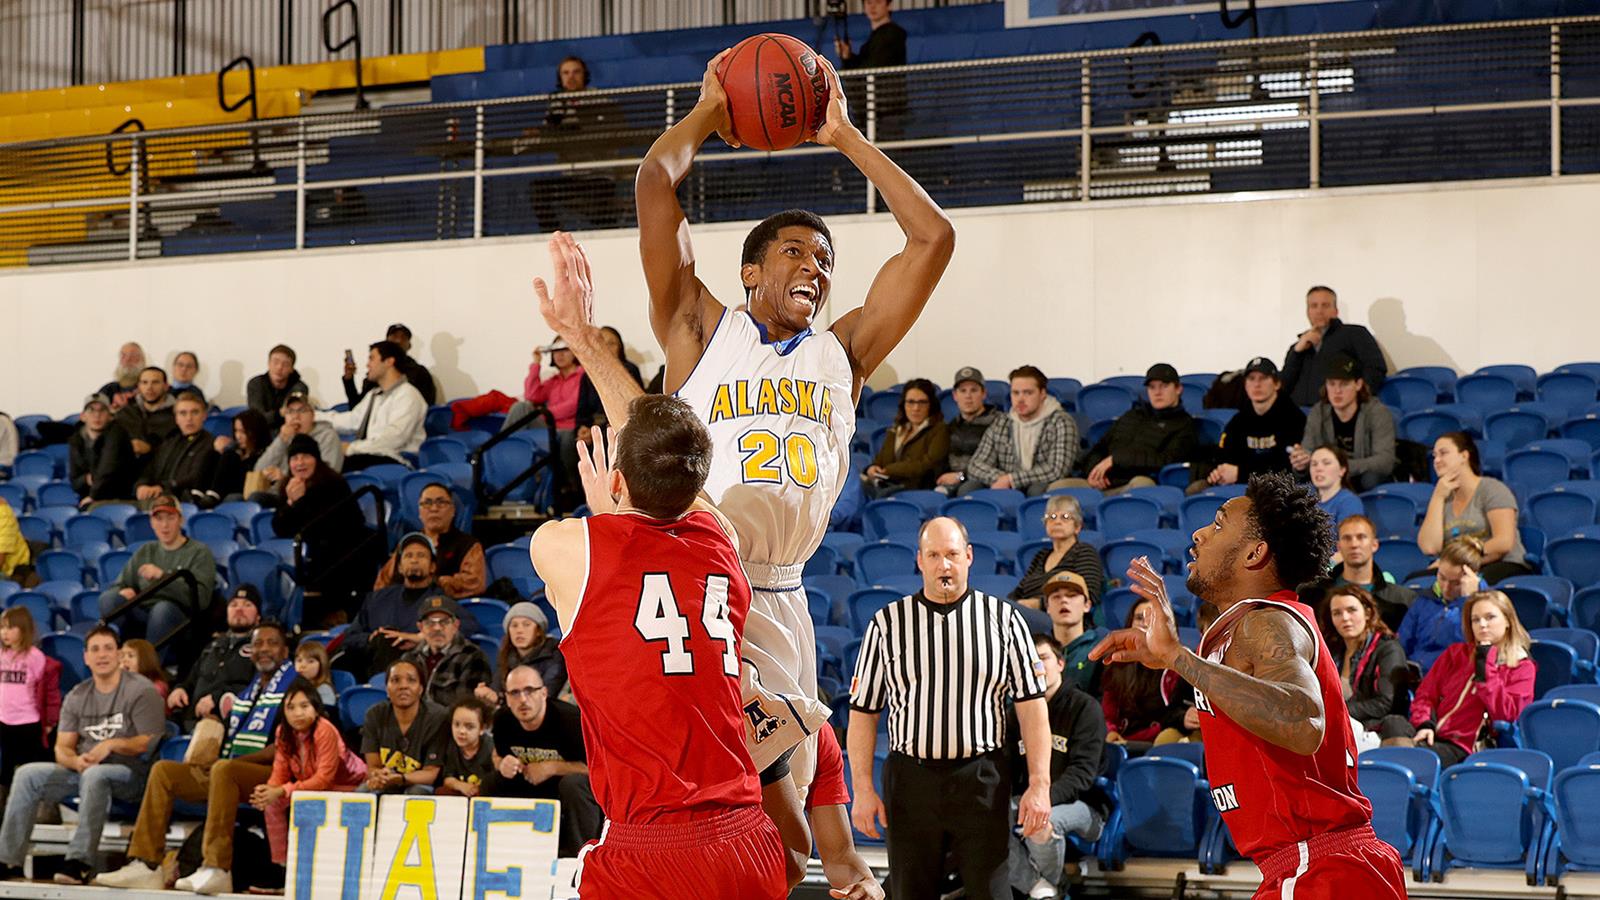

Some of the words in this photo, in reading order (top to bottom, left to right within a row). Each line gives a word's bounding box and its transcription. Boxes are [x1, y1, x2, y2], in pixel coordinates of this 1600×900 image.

[773, 72, 798, 129] NCAA
[708, 377, 832, 431] ALASKA
[737, 428, 819, 489] 20
[632, 570, 740, 679] 44
